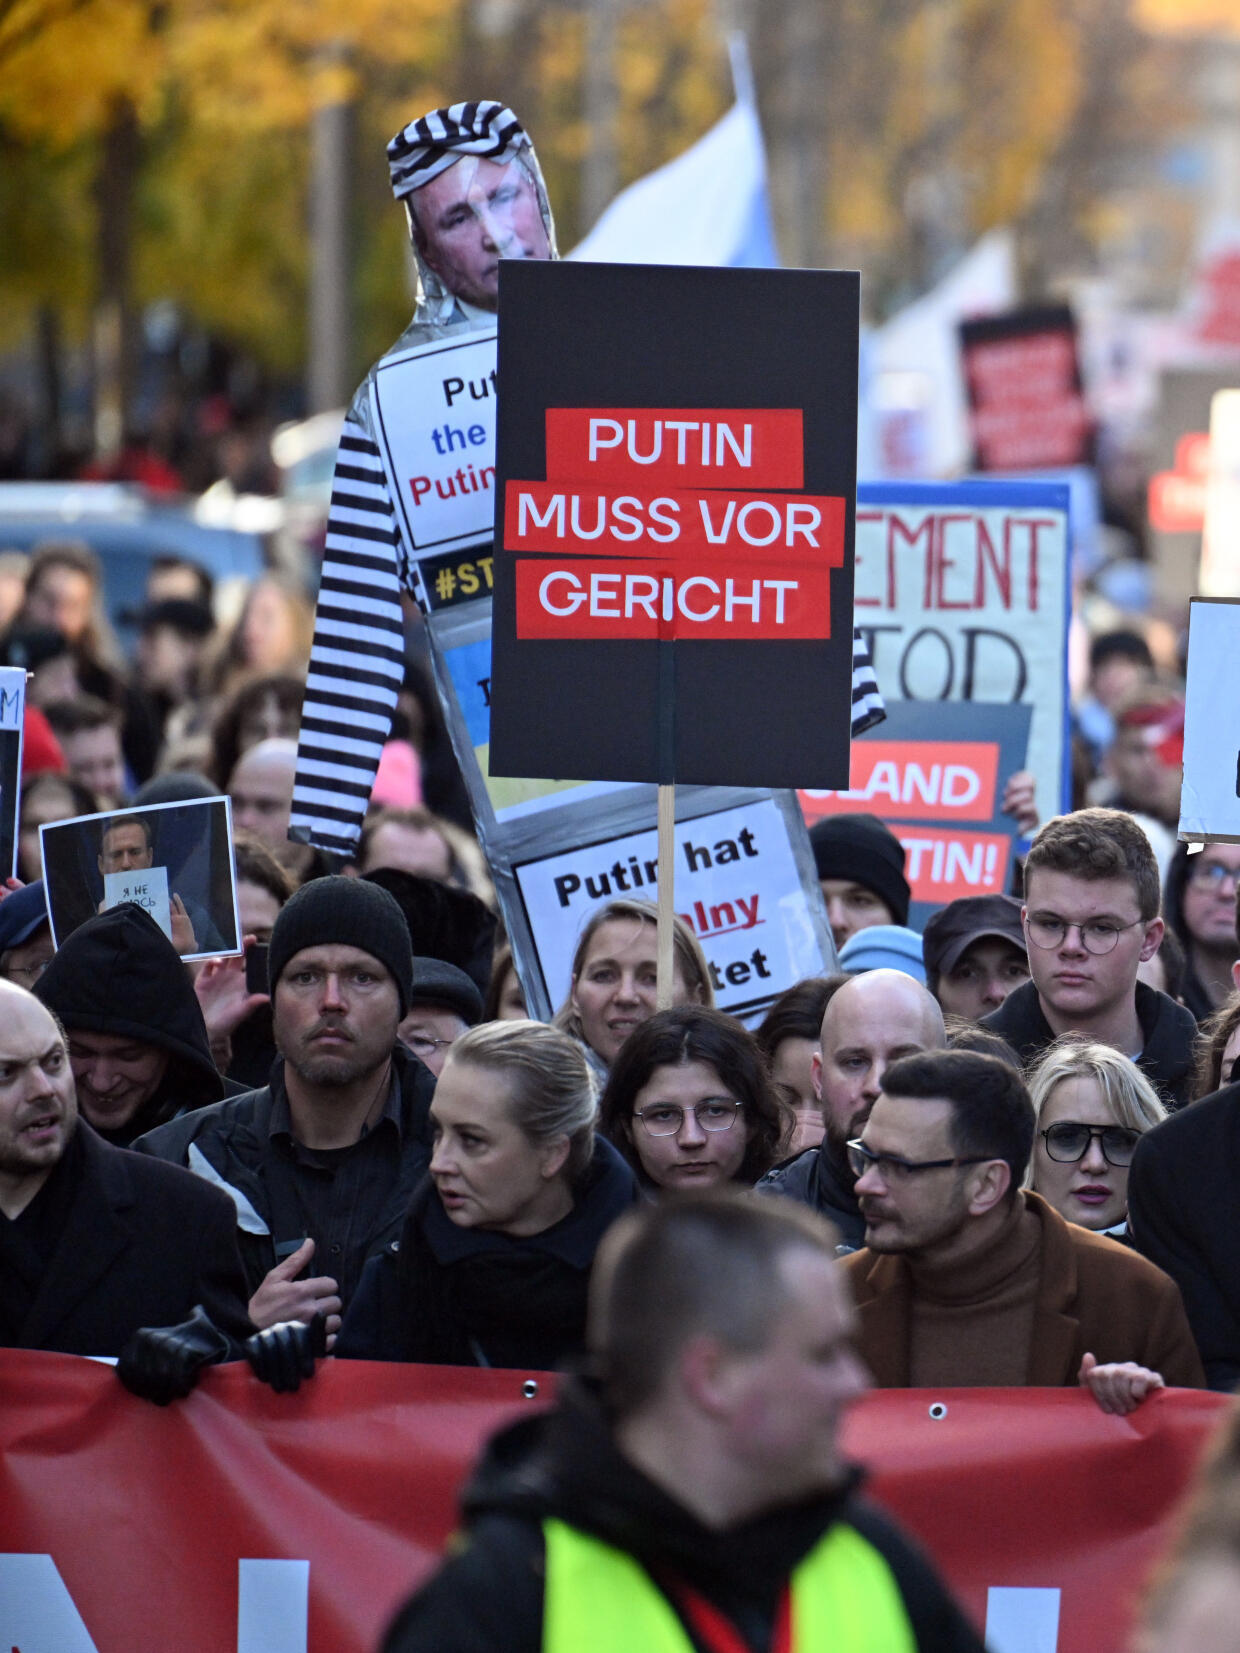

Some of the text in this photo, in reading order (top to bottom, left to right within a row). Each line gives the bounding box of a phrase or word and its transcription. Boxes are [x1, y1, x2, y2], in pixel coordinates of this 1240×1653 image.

[432, 424, 486, 455] the
[588, 418, 752, 467] PUTIN
[518, 493, 822, 548] MUSS VOR
[539, 570, 798, 624] GERICHT
[683, 827, 759, 872] hat
[134, 885, 149, 895] НЕ
